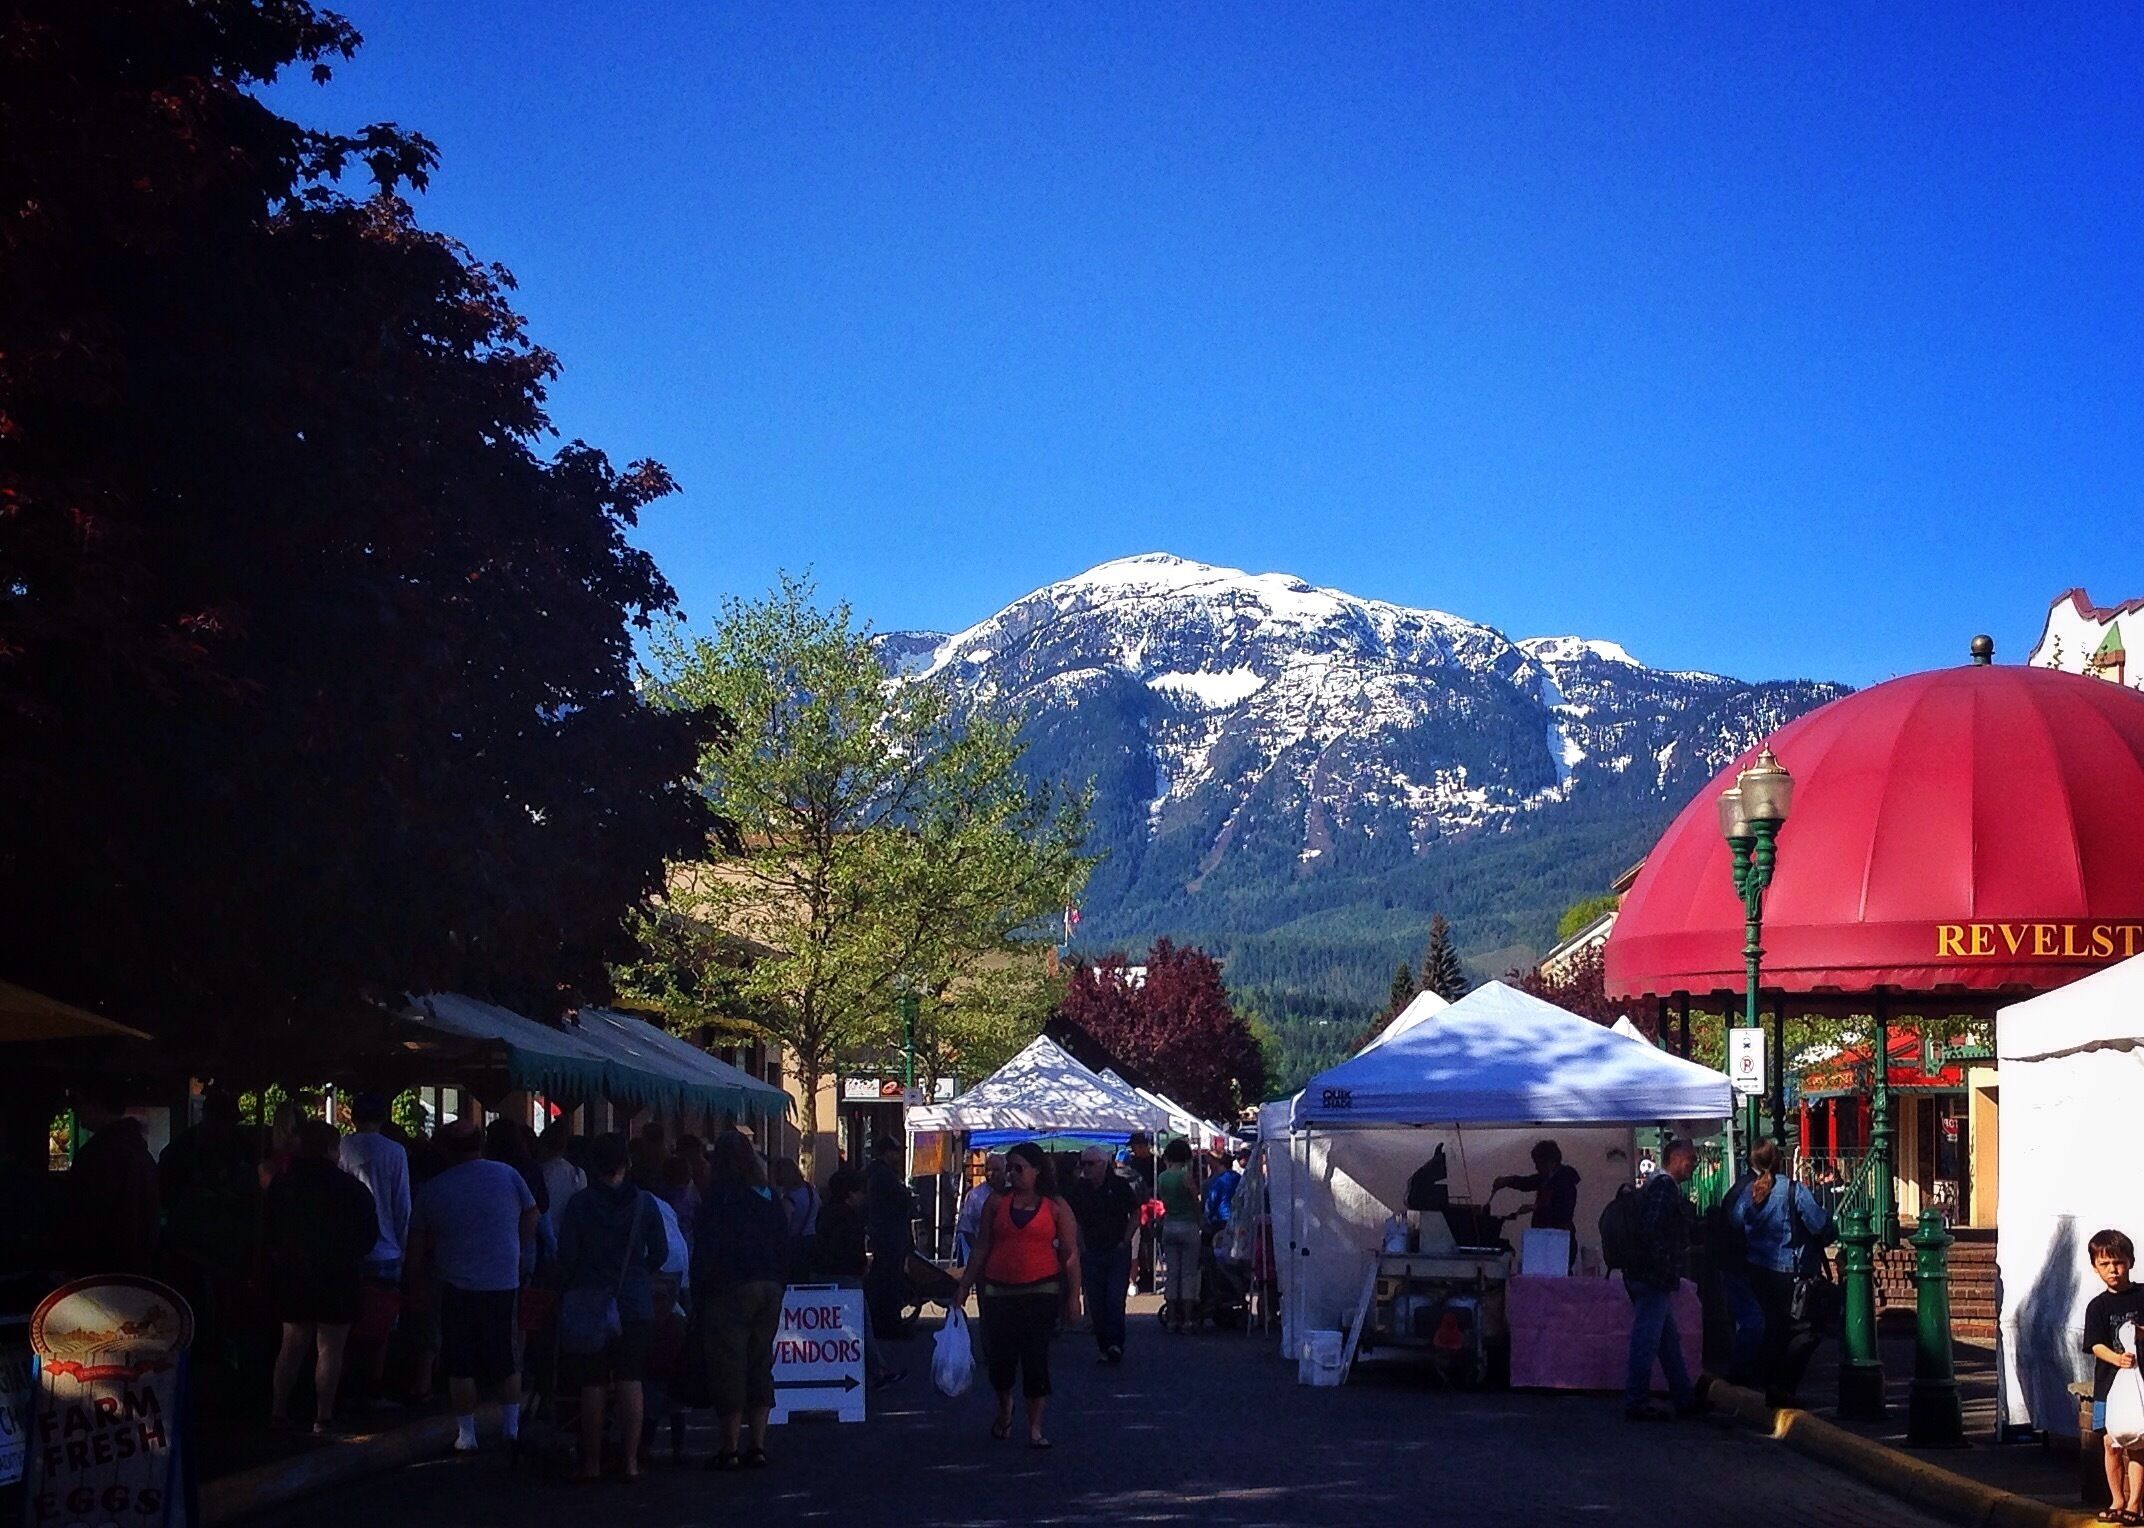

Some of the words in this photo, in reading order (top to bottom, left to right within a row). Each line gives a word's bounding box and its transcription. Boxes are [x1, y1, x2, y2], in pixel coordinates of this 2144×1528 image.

[1935, 924, 2143, 957] REVELST
[784, 1306, 842, 1330] MORE
[38, 1386, 161, 1443] FARM
[43, 1419, 167, 1477] FRESH
[35, 1485, 162, 1520] EGGS
